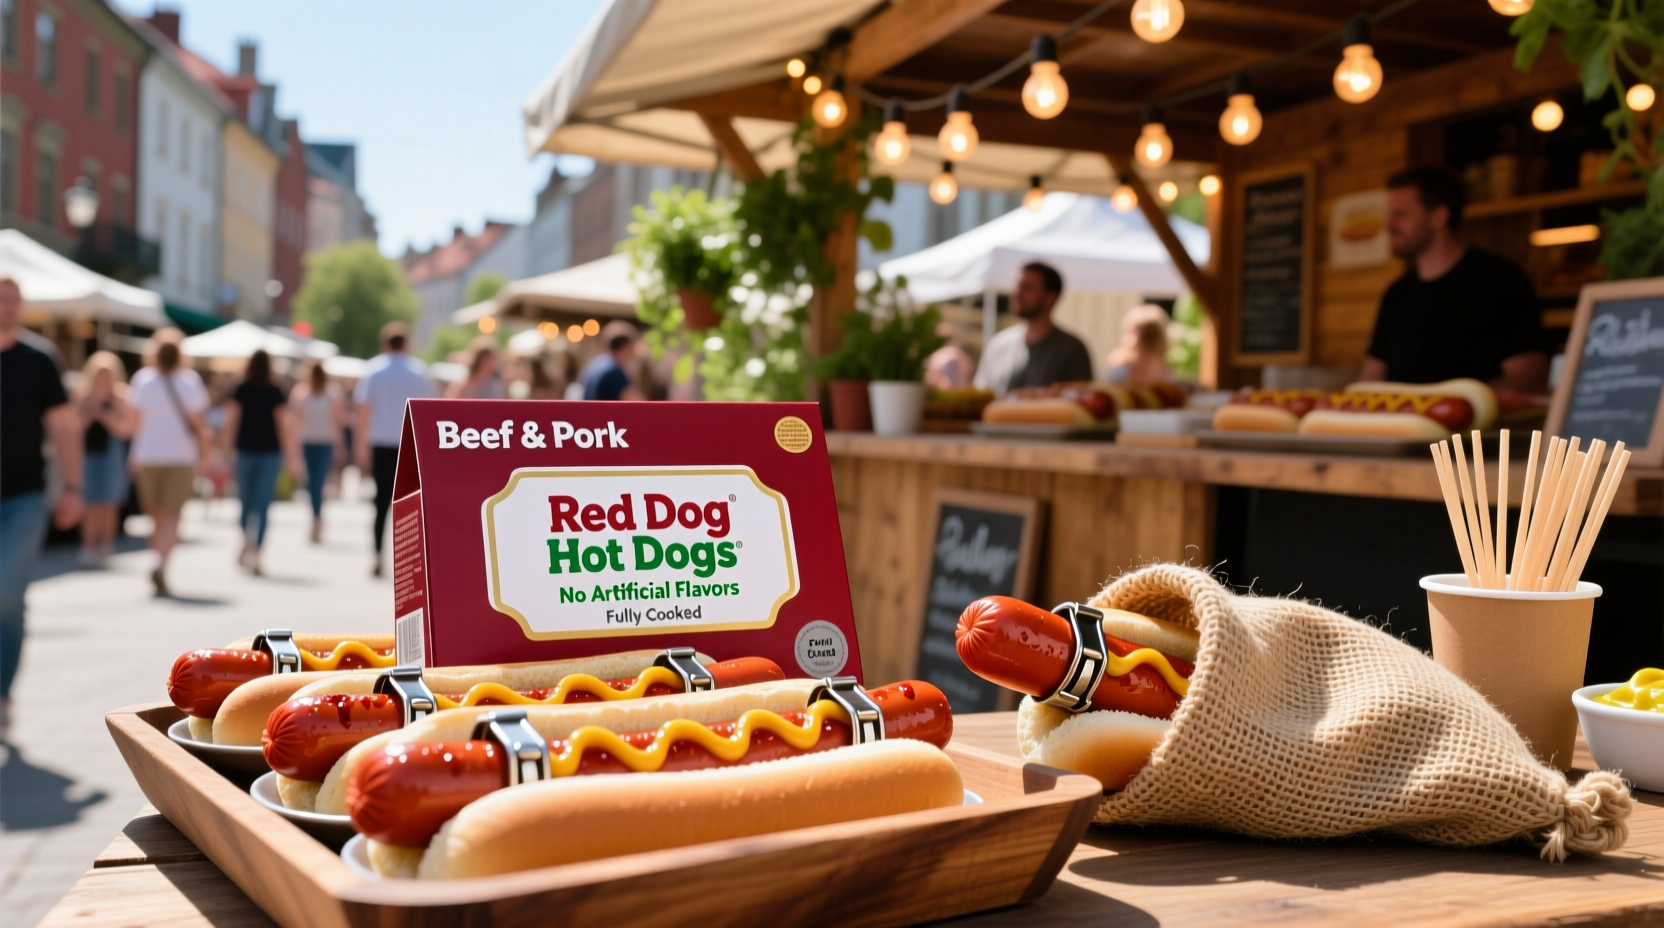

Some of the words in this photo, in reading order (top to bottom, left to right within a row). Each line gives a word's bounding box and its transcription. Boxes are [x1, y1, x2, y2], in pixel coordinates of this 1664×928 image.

[436, 419, 514, 449] Beef
[520, 420, 547, 449] &
[551, 421, 630, 449] Pork
[548, 493, 637, 533] Red
[547, 538, 625, 574] Hot
[559, 586, 587, 604] No
[591, 581, 671, 602] Artificial
[675, 580, 740, 598] Flavors
[606, 607, 641, 626] Fully
[646, 605, 702, 622] Cooked
